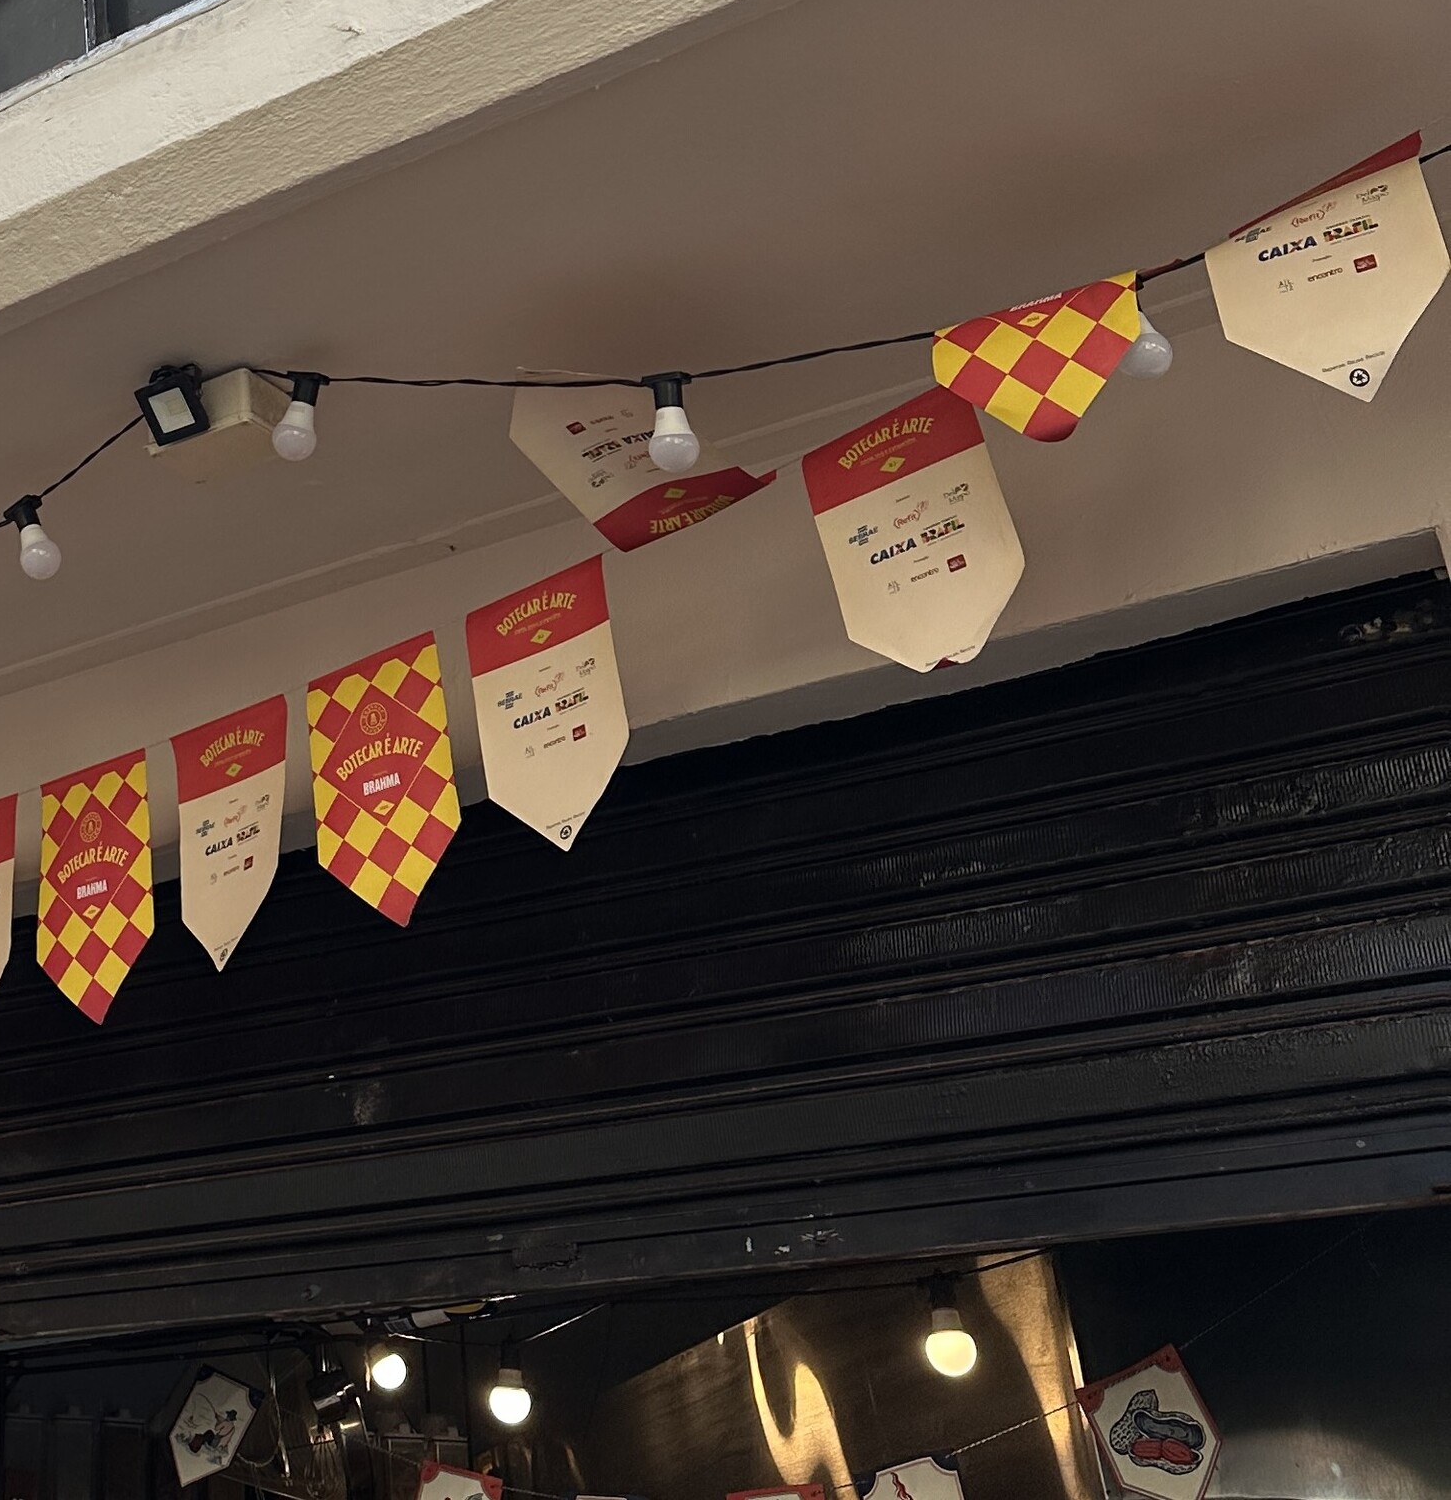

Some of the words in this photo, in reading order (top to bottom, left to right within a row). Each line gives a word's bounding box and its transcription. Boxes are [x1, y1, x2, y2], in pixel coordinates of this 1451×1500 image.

[1258, 235, 1318, 263] CAIXA
[1307, 266, 1343, 282] encontro
[837, 426, 890, 470] BOTECAR
[901, 416, 935, 435] ARTE
[870, 538, 917, 565] CAIXA
[496, 599, 540, 637] BOTECAR
[549, 592, 577, 610] ARTE
[513, 706, 551, 729] CAIXA
[200, 732, 236, 768] BOTECAR
[242, 728, 265, 748] ARTE
[336, 741, 383, 782] BOTECAR
[384, 732, 392, 755] É
[392, 737, 424, 759] ARTE
[363, 771, 401, 797] BRAHMA
[205, 836, 233, 856] CAIXA
[57, 848, 96, 884] BOTECAR
[103, 845, 129, 867] ARTE
[76, 879, 108, 900] BRAHMA
